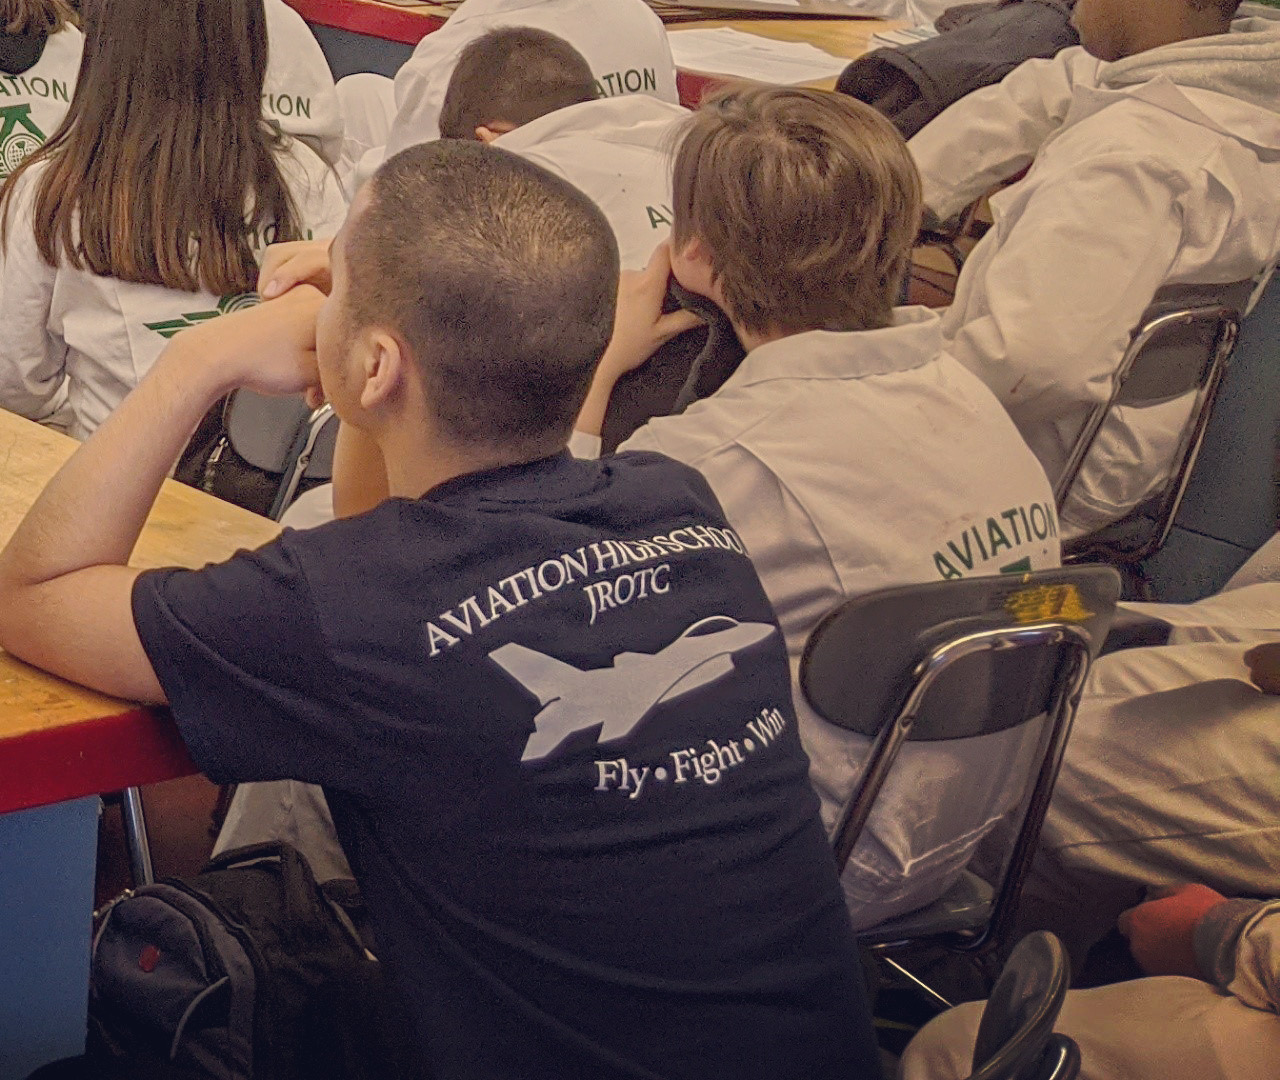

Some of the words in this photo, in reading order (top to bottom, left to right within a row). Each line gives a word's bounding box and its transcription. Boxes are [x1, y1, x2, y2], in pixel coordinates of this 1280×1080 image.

[933, 502, 1057, 580] AVIATION
[424, 546, 590, 657] AVIATION
[592, 539, 670, 572] HIGH
[583, 564, 671, 625] JROTC
[594, 758, 649, 799] Fly
[669, 739, 743, 785] Fight
[751, 707, 786, 749] Win
